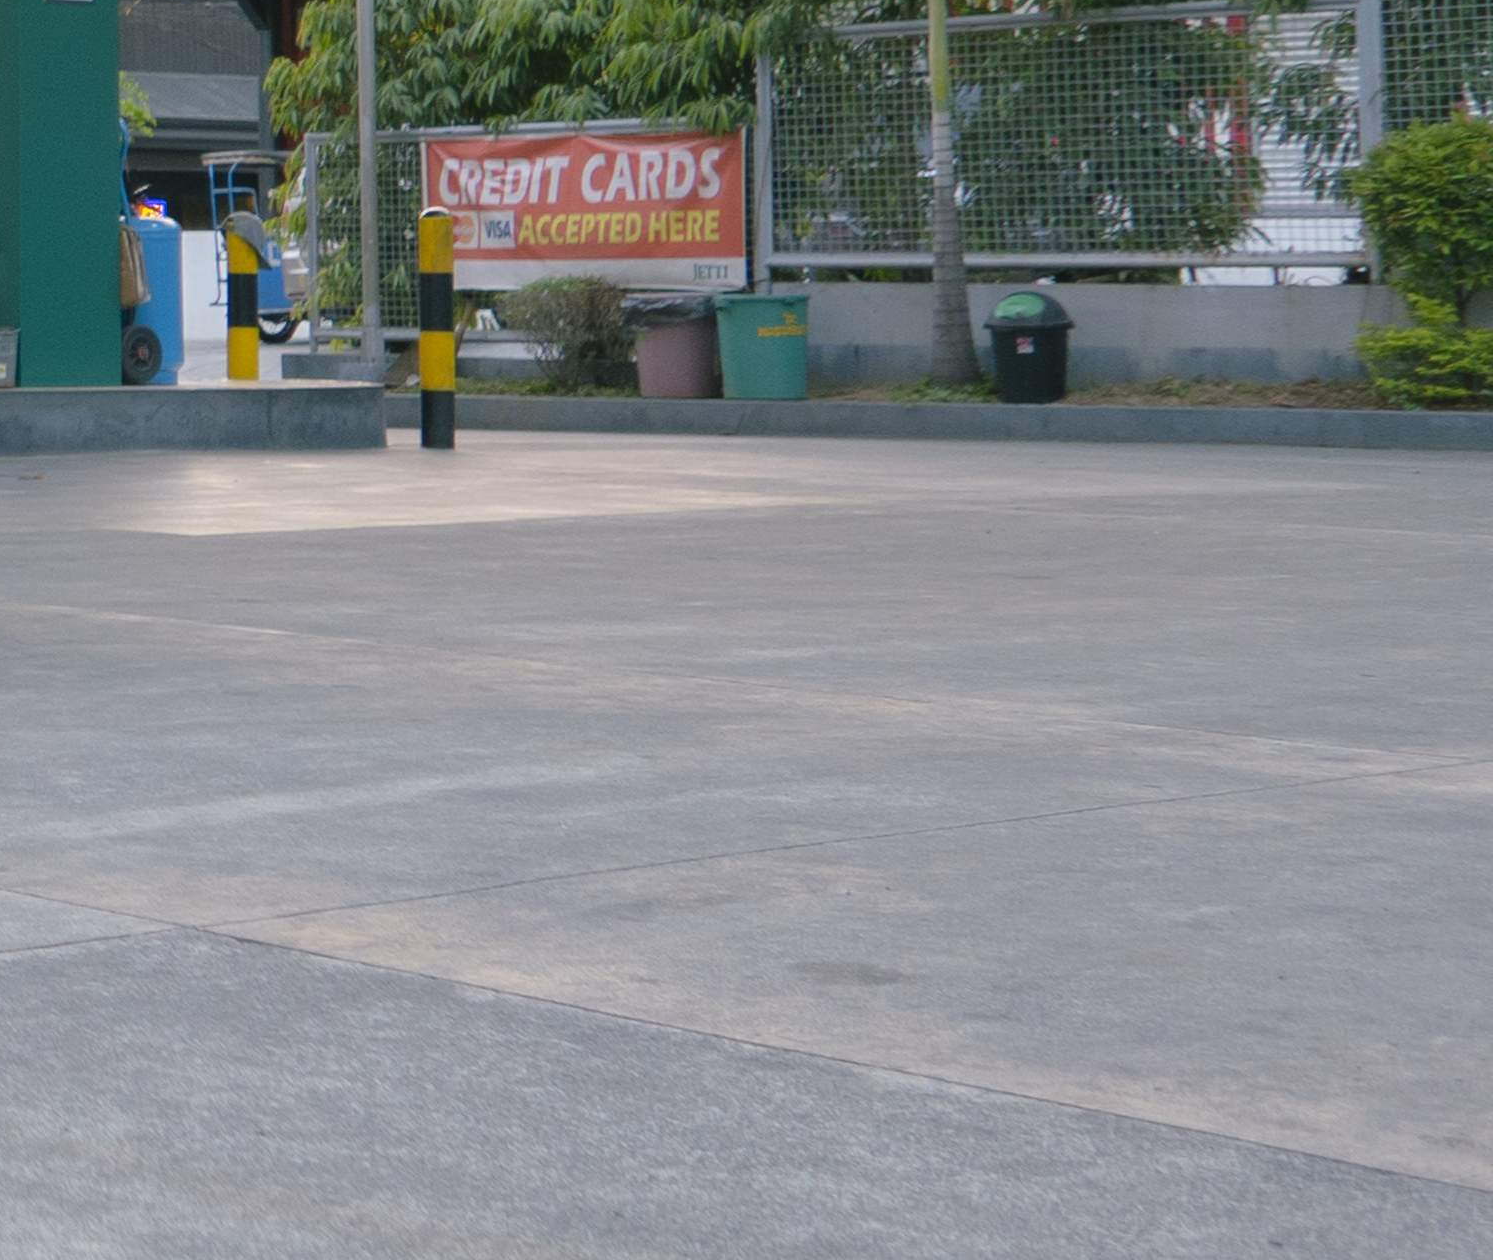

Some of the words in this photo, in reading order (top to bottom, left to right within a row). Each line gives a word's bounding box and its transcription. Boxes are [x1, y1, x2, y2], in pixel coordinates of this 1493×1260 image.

[439, 156, 569, 205] CREDIT
[581, 147, 724, 203] CARDS
[484, 220, 511, 239] VISA
[518, 212, 642, 246] ACCEPTED
[647, 209, 721, 244] HERE
